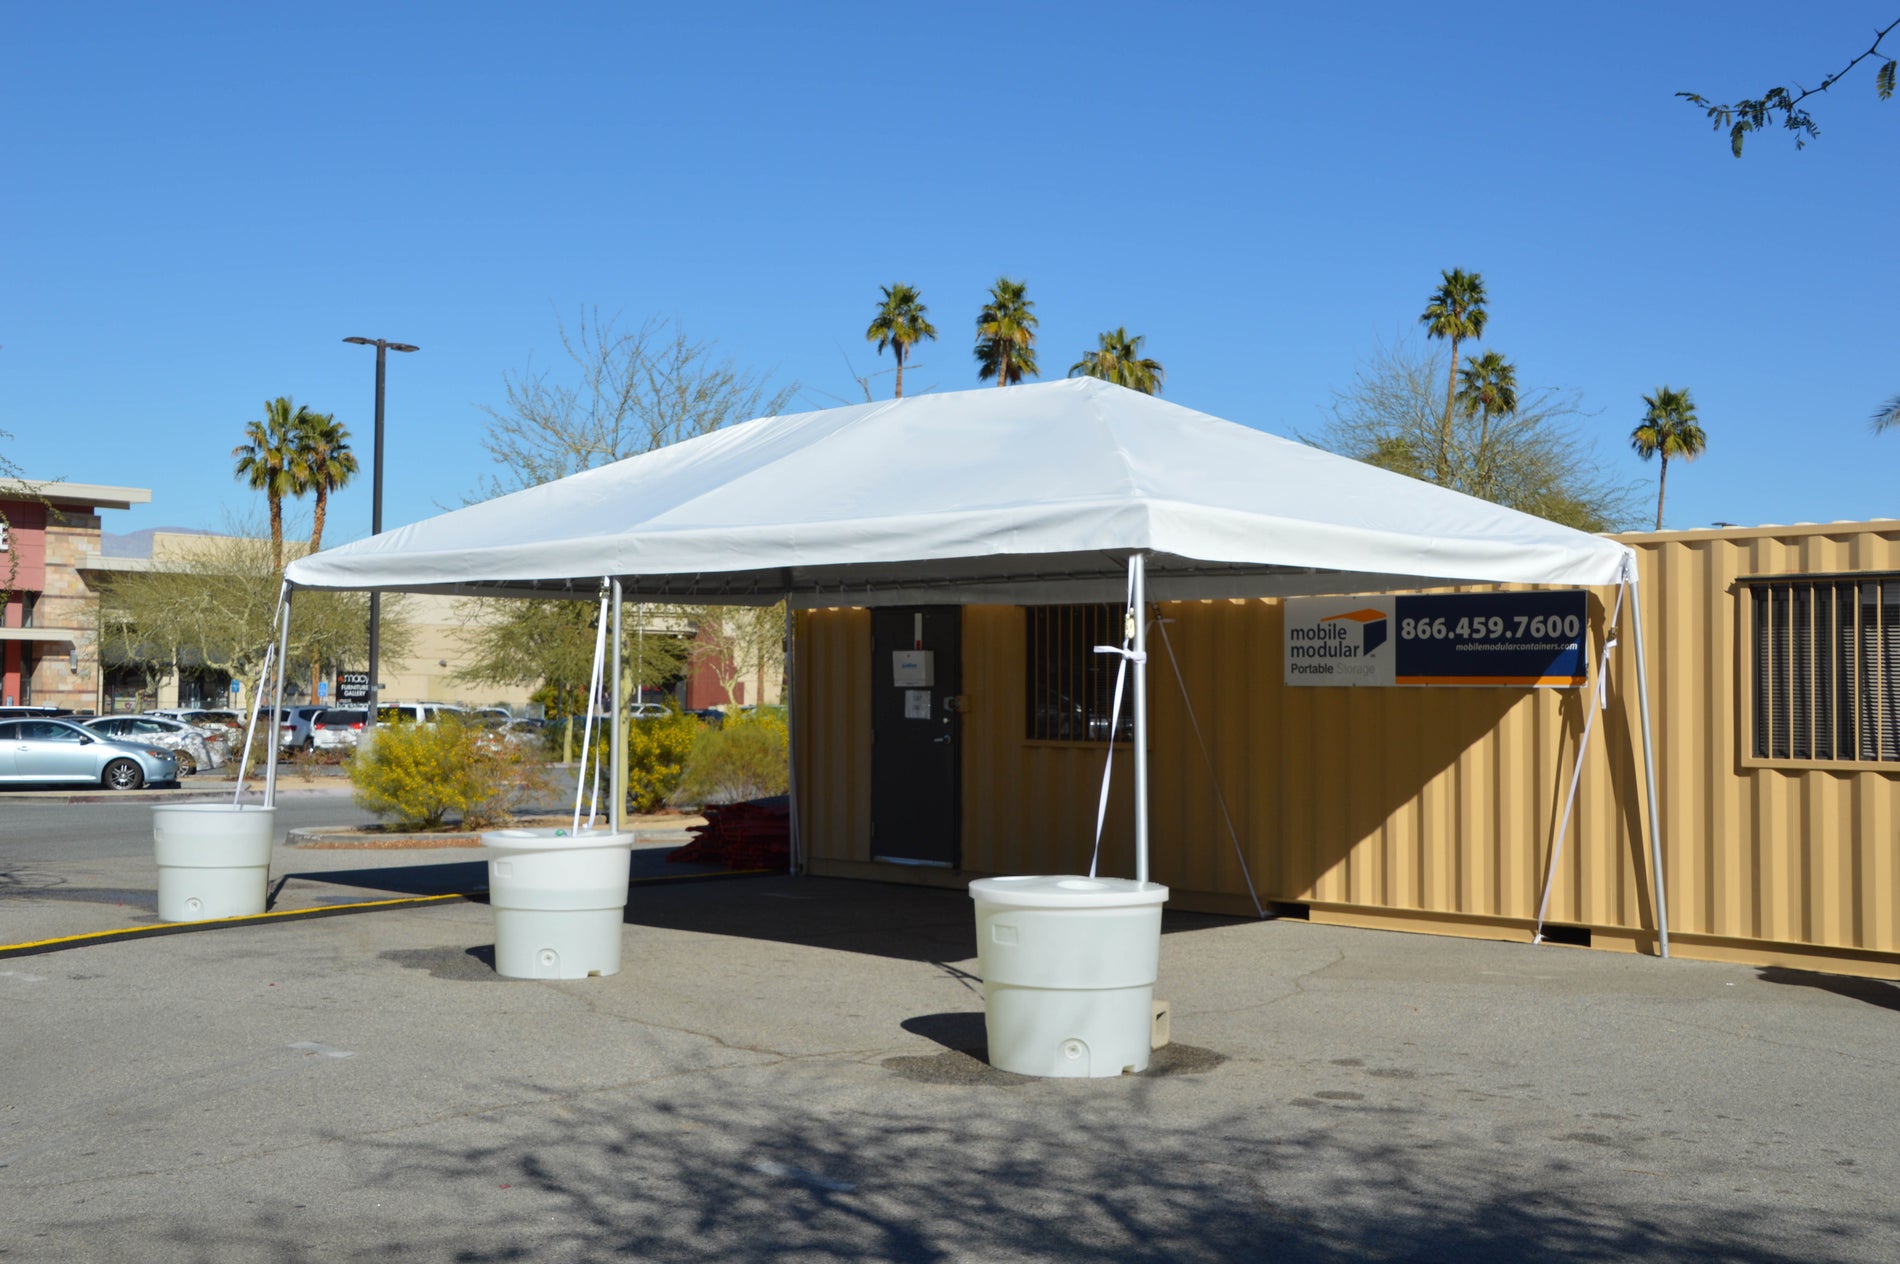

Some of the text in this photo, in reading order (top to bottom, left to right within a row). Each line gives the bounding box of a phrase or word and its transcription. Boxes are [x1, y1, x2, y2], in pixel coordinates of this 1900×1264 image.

[1290, 623, 1347, 641] mobile
[1401, 615, 1580, 640] 866.459.7600
[1290, 641, 1360, 658] modular
[1455, 642, 1578, 651] mobilemodularcontainers.com
[1290, 663, 1334, 674] Portable
[1336, 663, 1376, 677] Storage
[344, 674, 369, 684] macy
